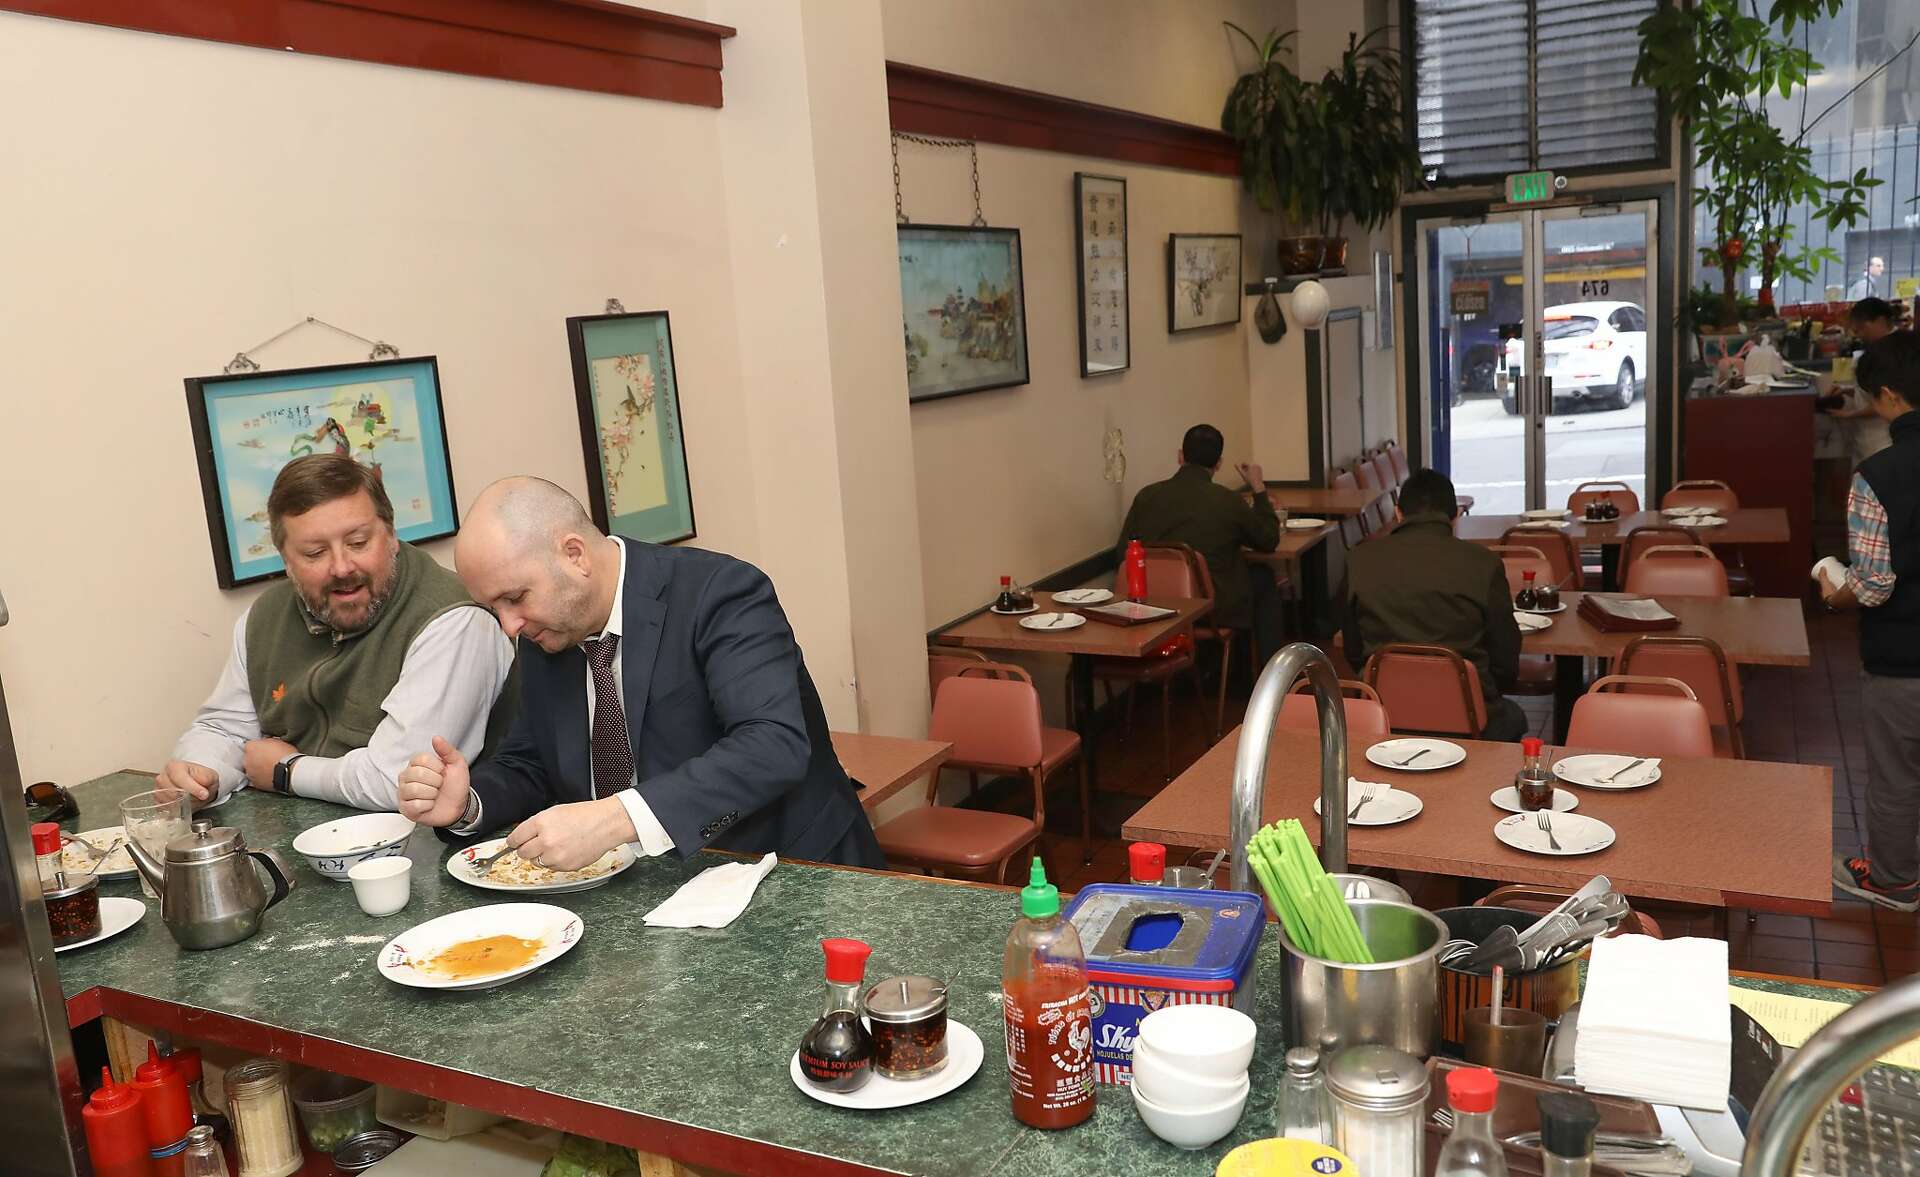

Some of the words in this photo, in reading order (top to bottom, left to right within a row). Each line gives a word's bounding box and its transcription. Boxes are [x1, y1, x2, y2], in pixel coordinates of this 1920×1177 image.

[1512, 173, 1548, 202] EXIT
[1096, 1049, 1125, 1060] HOJUELAS
[831, 1060, 847, 1070] SOY
